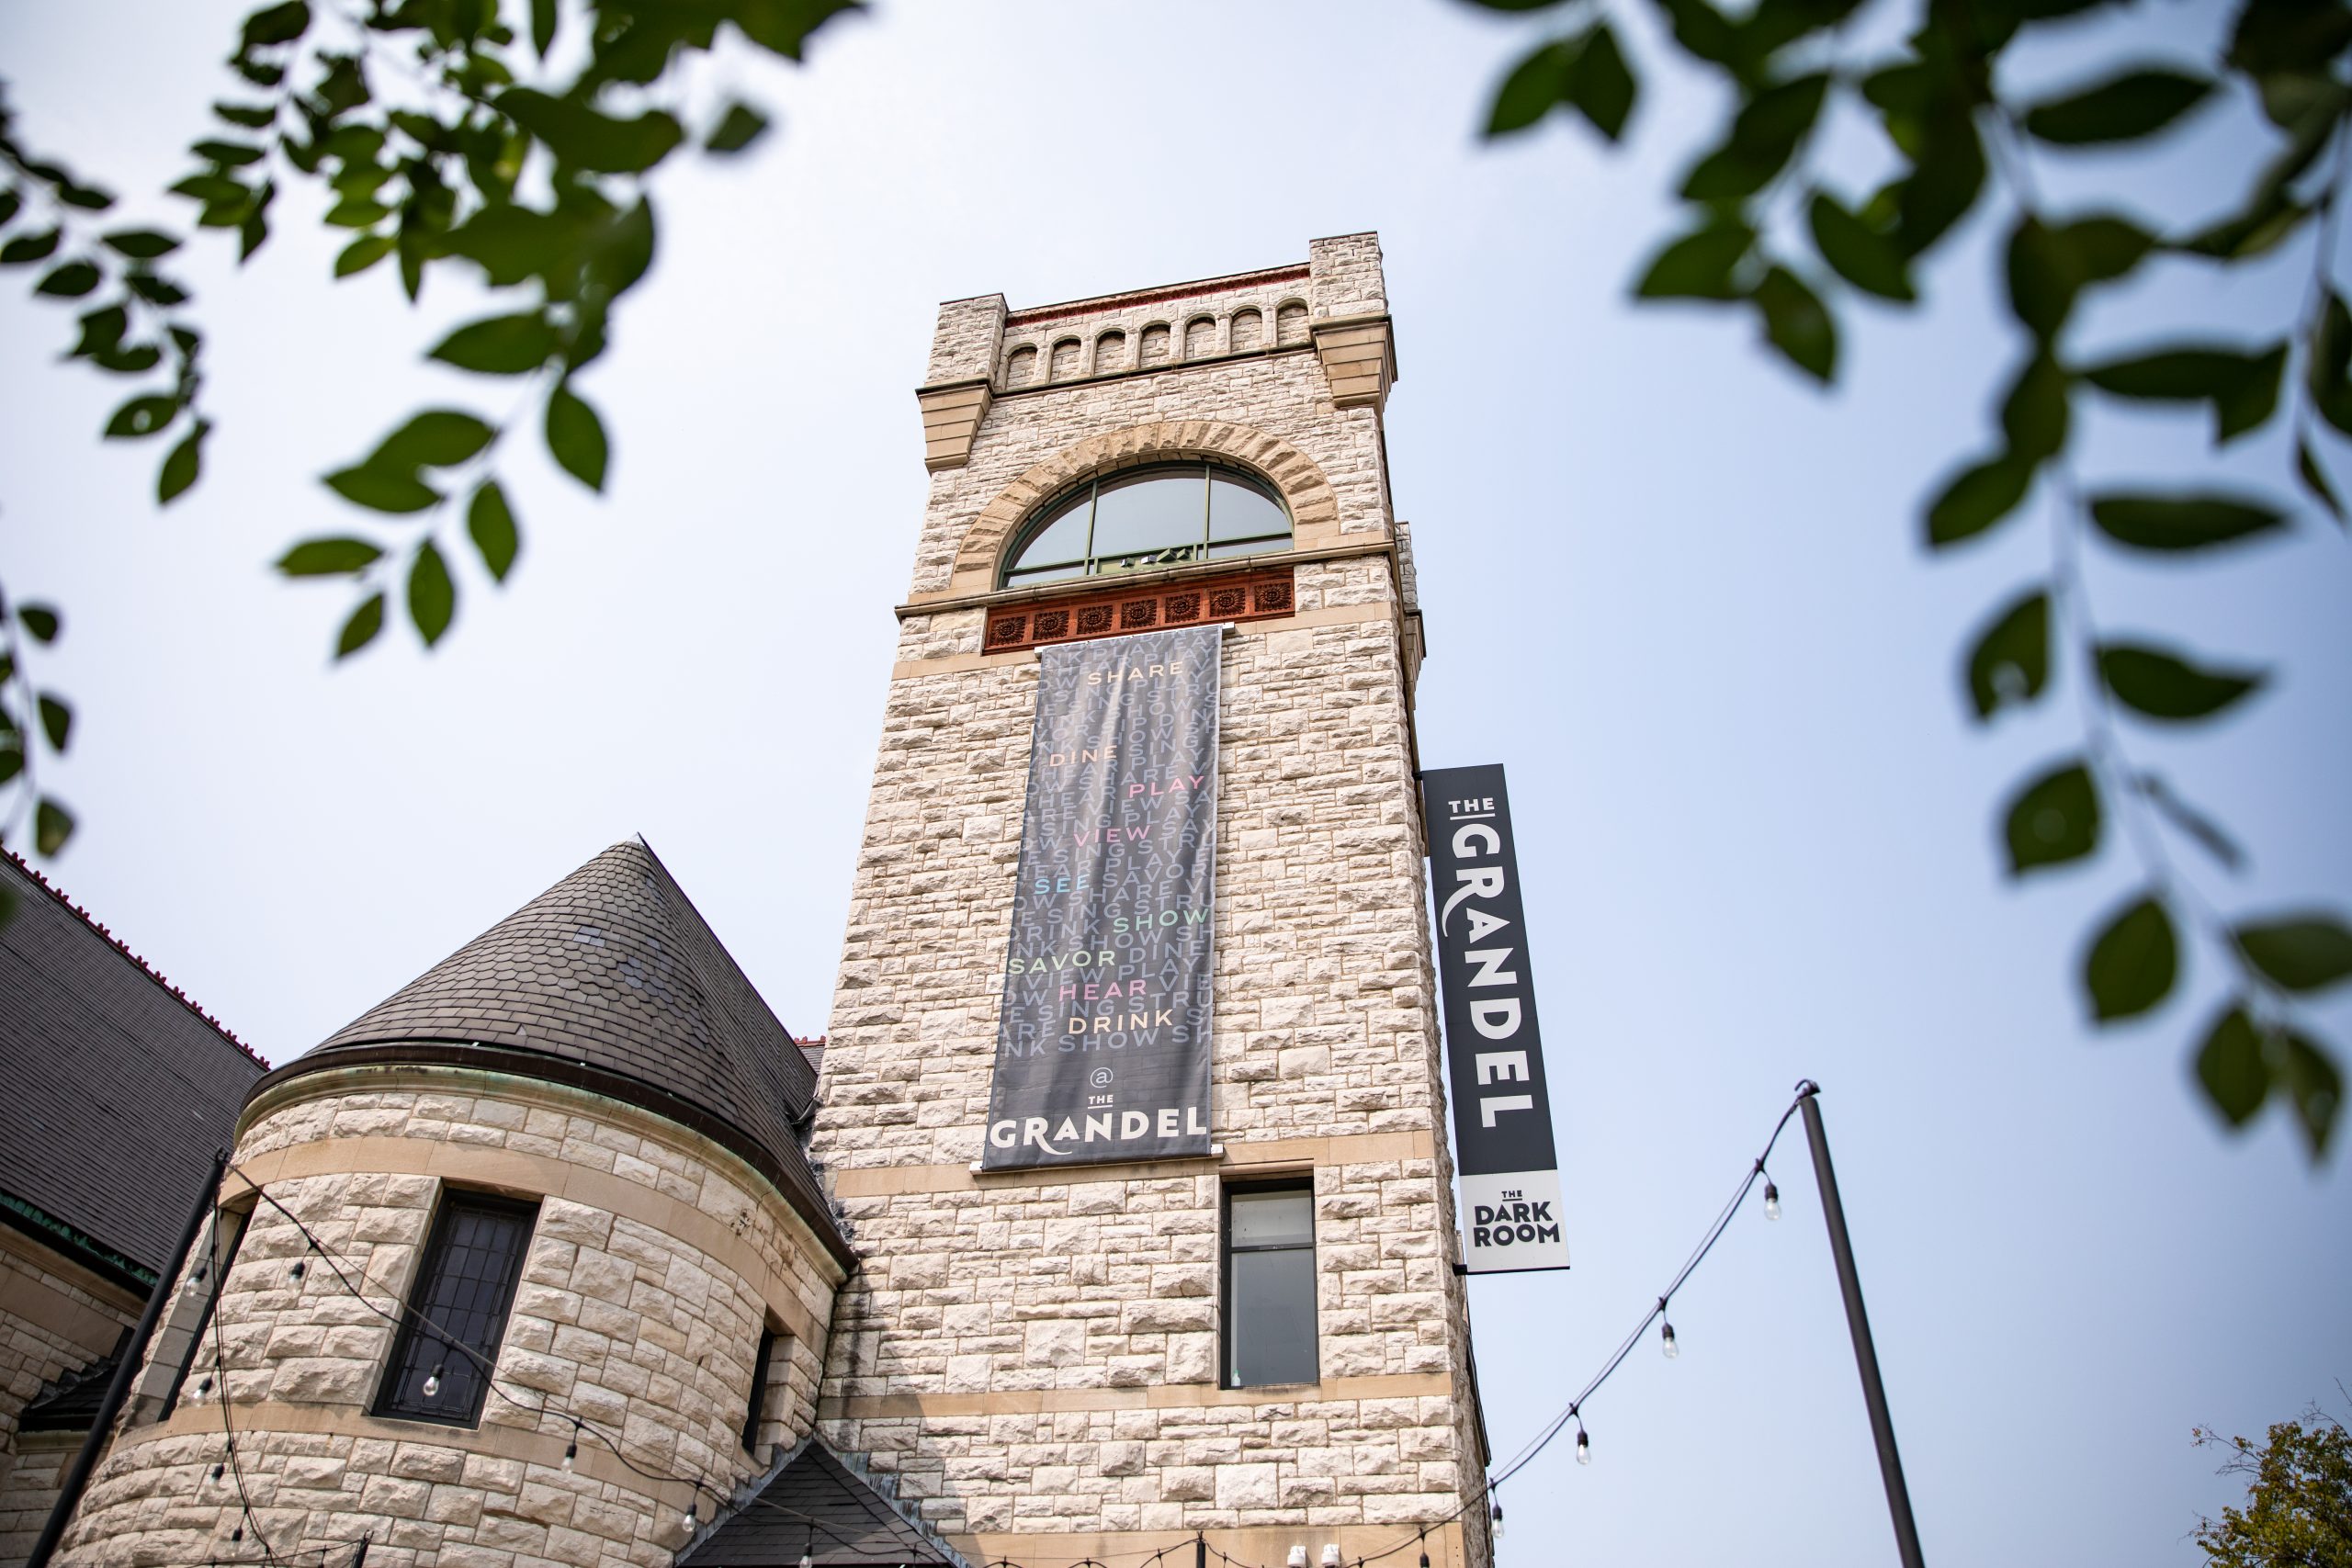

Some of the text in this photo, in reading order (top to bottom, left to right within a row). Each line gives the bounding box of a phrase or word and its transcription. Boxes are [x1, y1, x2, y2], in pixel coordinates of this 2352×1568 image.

[1094, 641, 1160, 660] PLAY
[1144, 646, 1213, 665] PLAY
[1087, 661, 1182, 684] SHARE
[1052, 671, 1203, 701] SING PLAY
[1069, 693, 1135, 713] SING
[1108, 699, 1192, 719] SHOW
[1102, 716, 1146, 733] SIP
[1087, 727, 1172, 749] SHOW
[1050, 746, 1116, 766] DINE
[1129, 737, 1197, 757] SING
[1040, 759, 1118, 780] HEAR
[1131, 748, 1203, 769] PLAY
[1079, 765, 1178, 789] SHARE
[1038, 775, 1203, 808] HEAR PLAY
[1087, 795, 1163, 816] VIEW
[1448, 797, 1495, 814] THE
[1040, 804, 1200, 837] SING PLAY
[1073, 824, 1149, 847] VIEW
[1053, 841, 1125, 863] SING
[1105, 849, 1181, 873] PLAY
[1034, 861, 1207, 895] SEE SAVOR
[1069, 880, 1172, 907] SHARE
[1046, 901, 1122, 924] SING
[1114, 907, 1208, 933] SHOW
[1069, 928, 1163, 953] SHOW
[1008, 940, 1204, 974] SAVOR DINE
[1024, 957, 1197, 988] VIEW PLAY
[1442, 823, 1533, 1128] GRANDEL
[1058, 979, 1146, 1001] HEAR
[1037, 998, 1114, 1020] SING
[1069, 1010, 1172, 1034] DRINK
[1057, 1028, 1158, 1053] SHOW
[1090, 1066, 1114, 1089] @
[1088, 1094, 1114, 1105] THE
[989, 1106, 1207, 1156] GRANDEL
[1501, 1190, 1523, 1199] THE
[1475, 1201, 1554, 1226] DARK
[1473, 1223, 1560, 1247] ROOM
